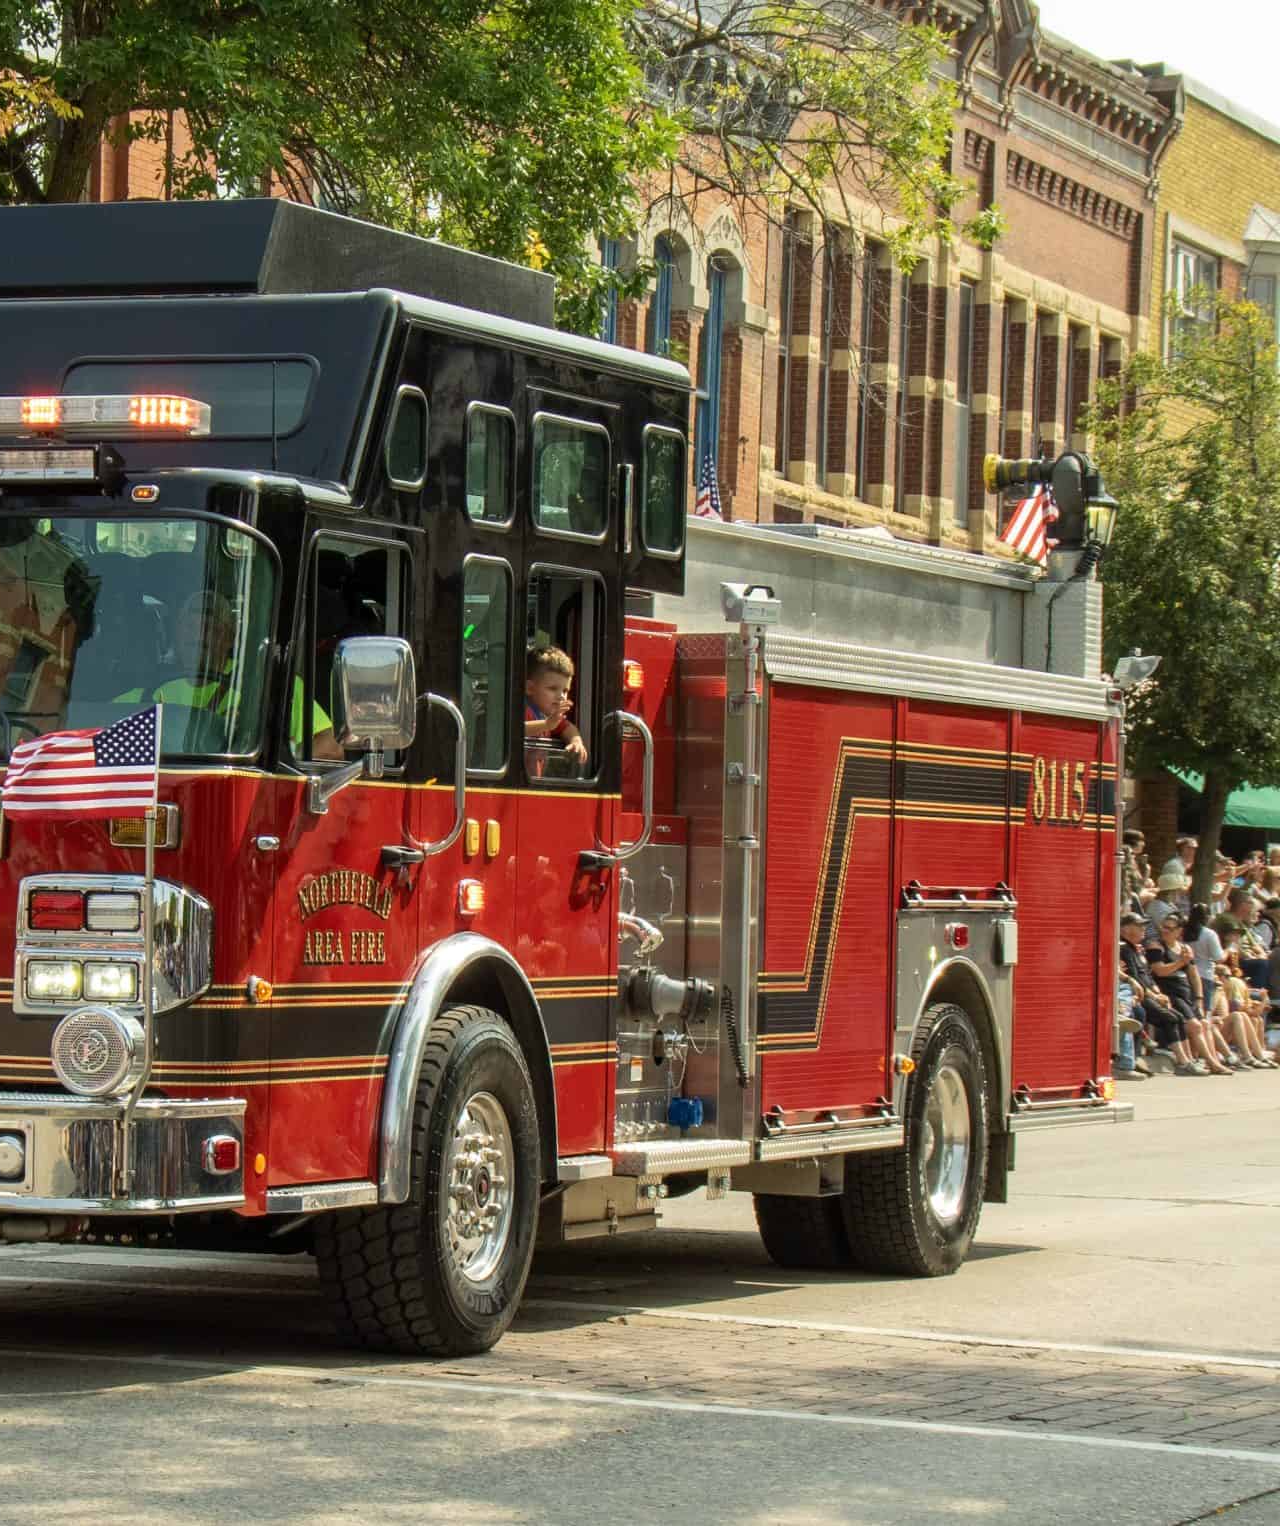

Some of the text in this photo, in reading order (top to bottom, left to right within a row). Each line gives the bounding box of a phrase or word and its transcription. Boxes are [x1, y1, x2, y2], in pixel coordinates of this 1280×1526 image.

[1033, 756, 1085, 826] 8115
[298, 869, 394, 921] NORTHFIELD
[303, 930, 386, 965] AREA FIRE
